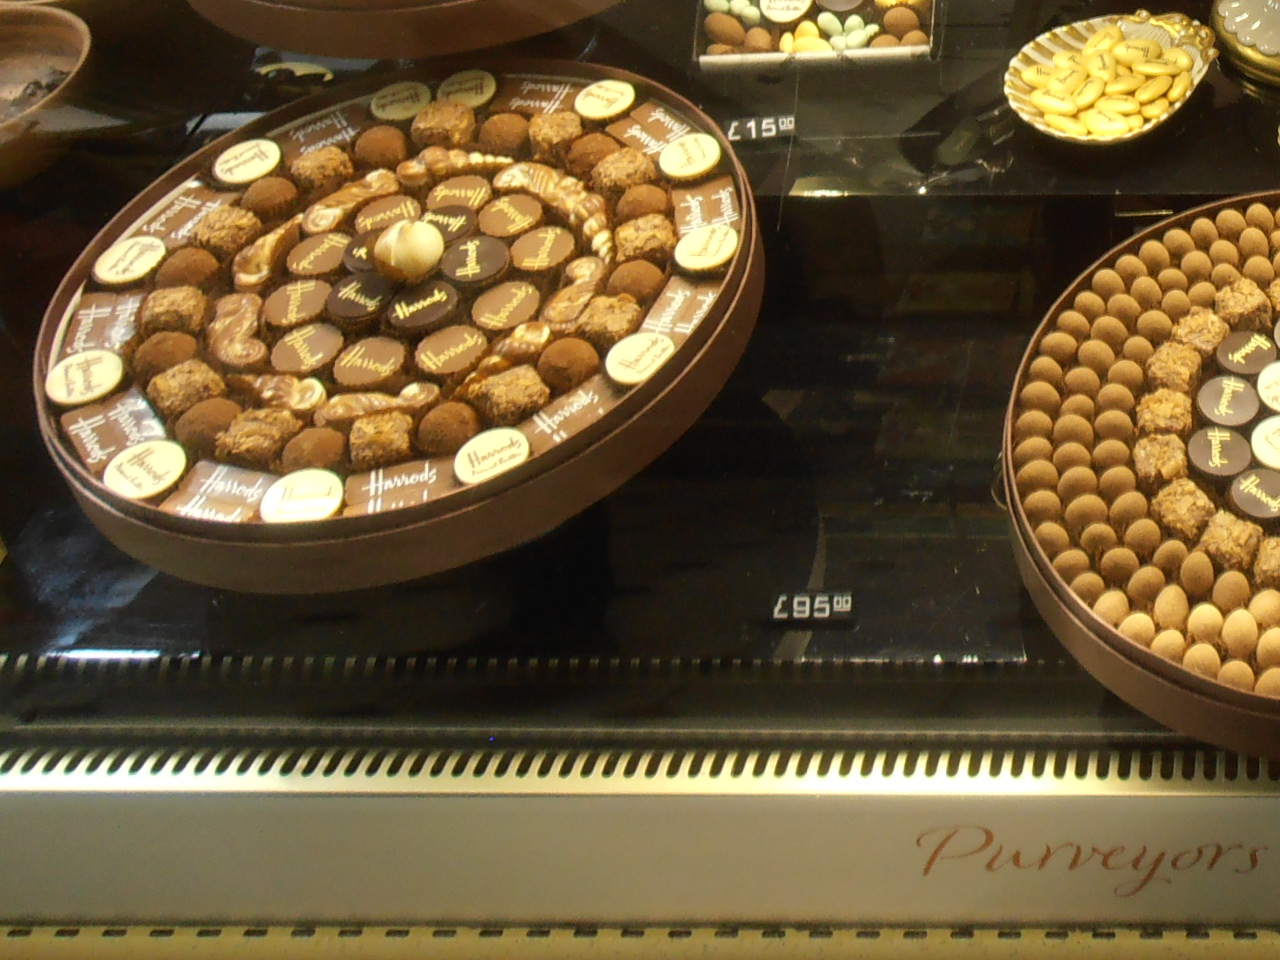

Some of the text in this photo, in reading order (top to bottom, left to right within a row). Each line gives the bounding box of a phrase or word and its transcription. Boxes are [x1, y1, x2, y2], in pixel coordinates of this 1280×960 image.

[434, 186, 487, 207] Harrods
[358, 200, 415, 231] Harrods
[336, 281, 384, 312] Harrods
[393, 288, 448, 321] Harrods
[477, 286, 533, 330] Harrods
[339, 346, 395, 378] Harrods
[420, 332, 483, 372] Harrods
[533, 389, 599, 434] Harrods
[467, 436, 522, 469] Harrods
[200, 465, 262, 503] Harrods
[362, 460, 438, 497] Harrods
[916, 824, 1269, 898] Purveyors
